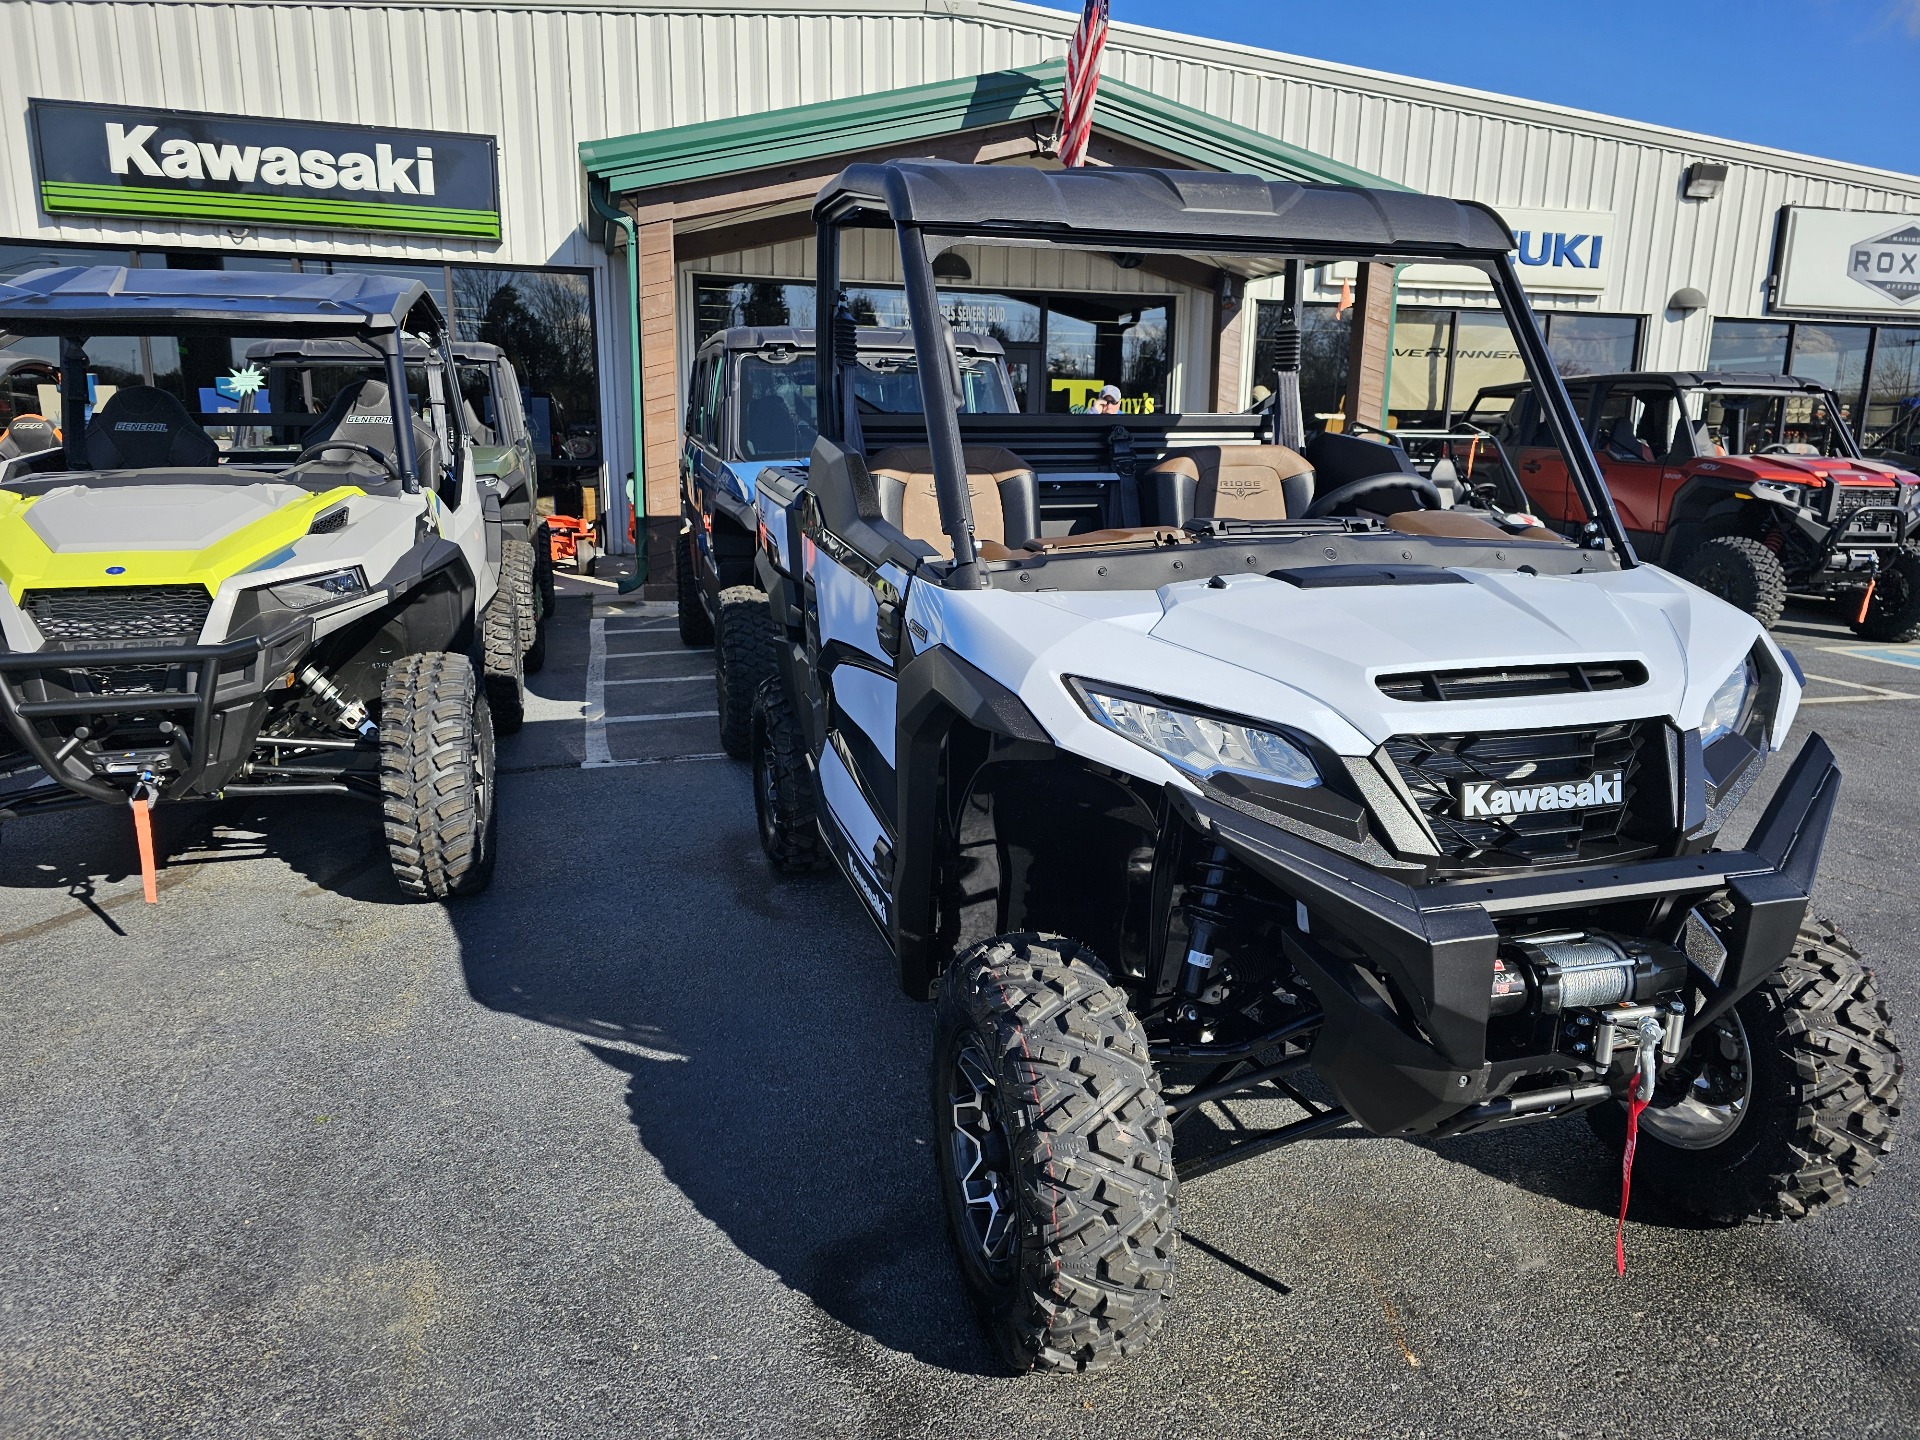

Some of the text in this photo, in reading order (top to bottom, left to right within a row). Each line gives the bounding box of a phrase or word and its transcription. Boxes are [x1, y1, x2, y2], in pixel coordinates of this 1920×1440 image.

[105, 122, 436, 196] Kawasaki
[1510, 229, 1604, 269] UKI
[1853, 250, 1918, 275] ROX
[1886, 283, 1920, 291] OFFROA
[957, 306, 986, 321] SEIVERS
[988, 306, 1008, 322] BLVD.
[114, 421, 168, 433] GENERAL
[1844, 497, 1892, 507] POLARIS
[1463, 770, 1624, 820] Kawasaki
[847, 851, 888, 926] Kawasaki
